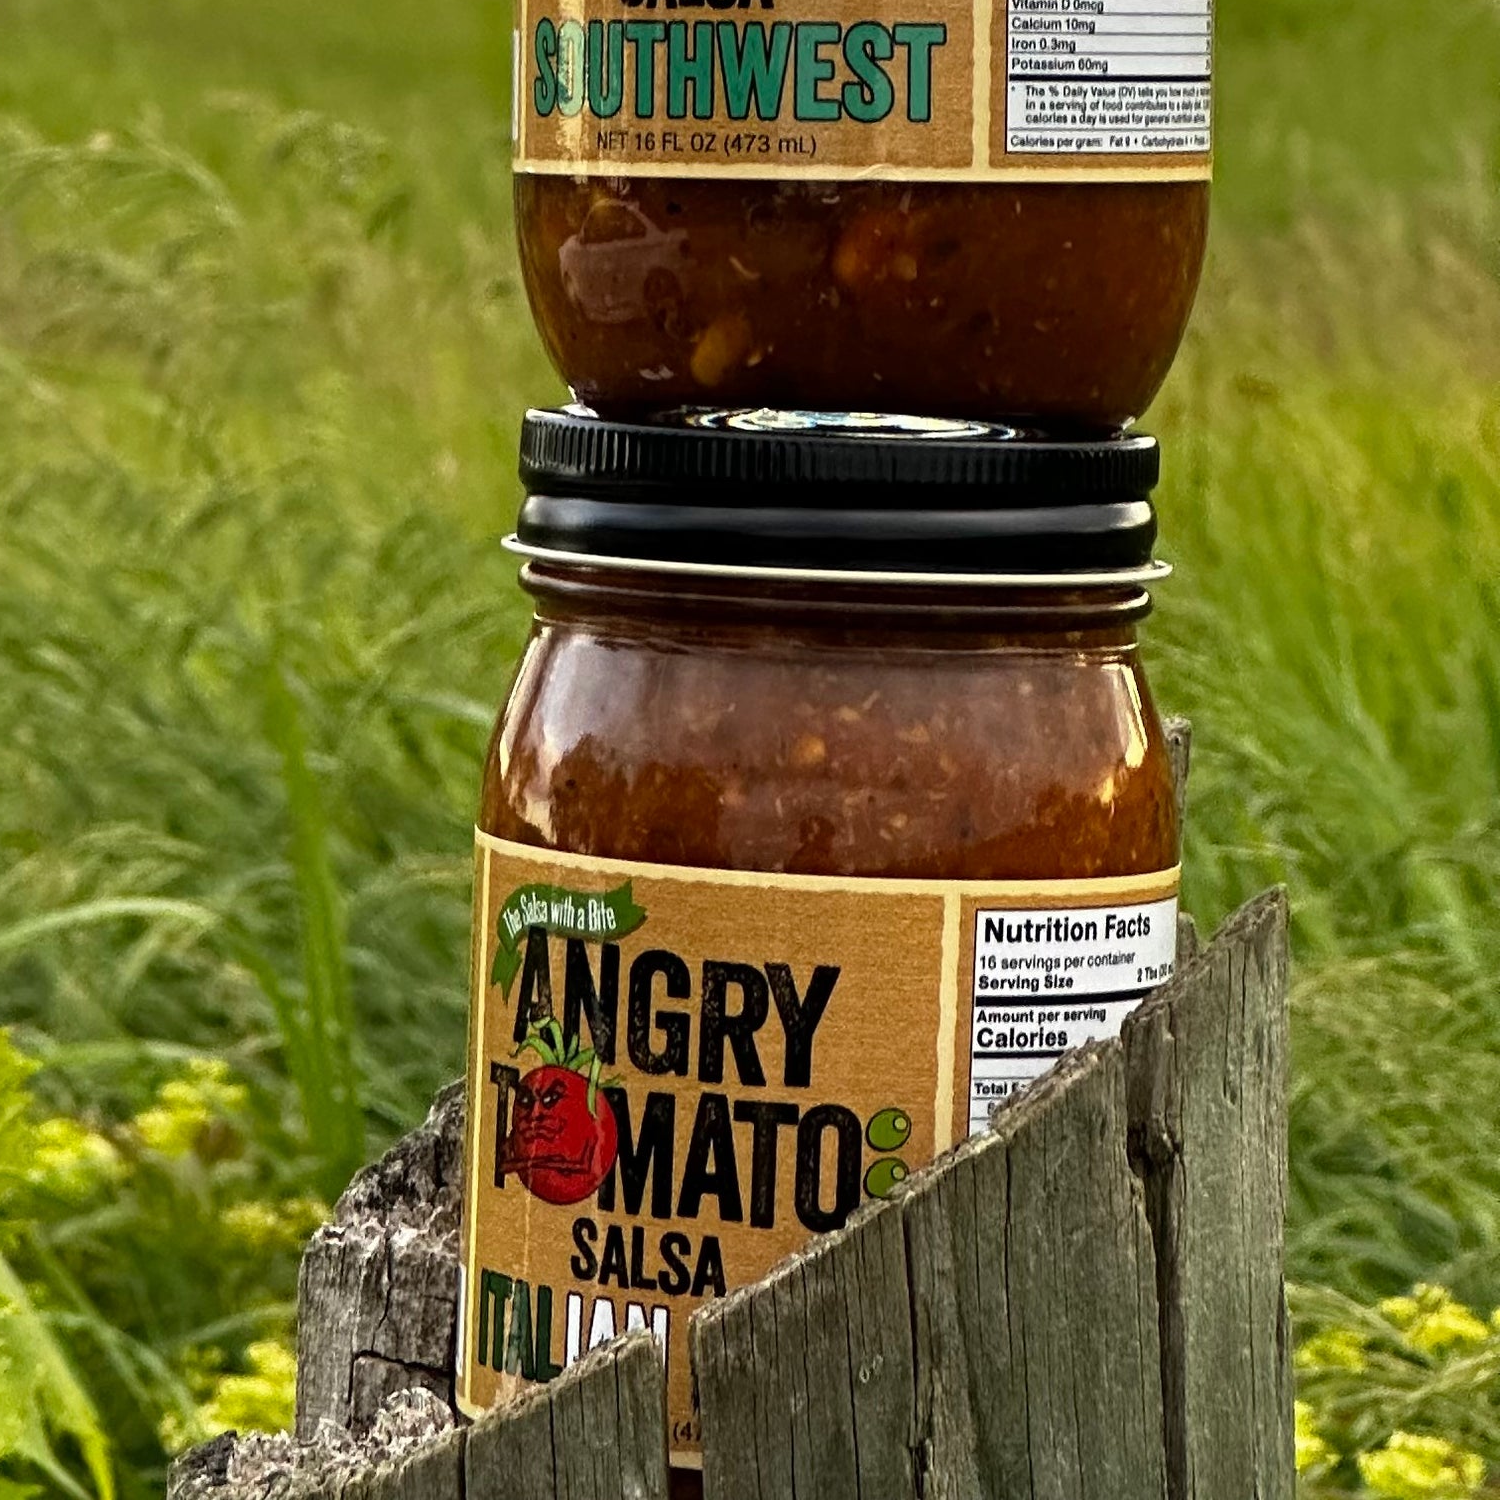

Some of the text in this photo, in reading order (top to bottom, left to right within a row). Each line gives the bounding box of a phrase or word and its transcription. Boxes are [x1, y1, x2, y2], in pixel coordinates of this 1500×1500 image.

[1012, 17, 1096, 34] Calcium 10mg
[1012, 38, 1076, 54] Iron 0.3mg
[534, 17, 947, 123] SOUTHWEST
[1012, 57, 1075, 70] Potassium
[1025, 85, 1045, 97] The
[1063, 85, 1087, 99] Daily
[1091, 86, 1116, 97] Value
[1040, 102, 1046, 110] a
[1050, 100, 1087, 113] serving
[1090, 100, 1100, 110] of
[1102, 100, 1122, 111] food
[1025, 113, 1067, 124] calories
[1071, 115, 1076, 124] a
[1079, 113, 1096, 126] day
[1108, 113, 1130, 124] used
[596, 131, 817, 156] NET 16 FL OZ (473 mL)
[1010, 135, 1054, 147] Calories
[1057, 136, 1074, 149] per
[503, 891, 617, 939] The Salsa with a Bite
[984, 912, 1150, 943] Nutrition Facts
[980, 951, 1135, 973] 16 servings per container
[978, 975, 1039, 992] Serving
[1044, 974, 1074, 989] Size
[513, 926, 842, 1088] ANGRY
[977, 1008, 1106, 1026] Amount per serving
[976, 1027, 1068, 1048] Calories
[974, 1082, 1008, 1095] Total
[570, 1217, 727, 1298] SALSA
[673, 1421, 701, 1444] (4
